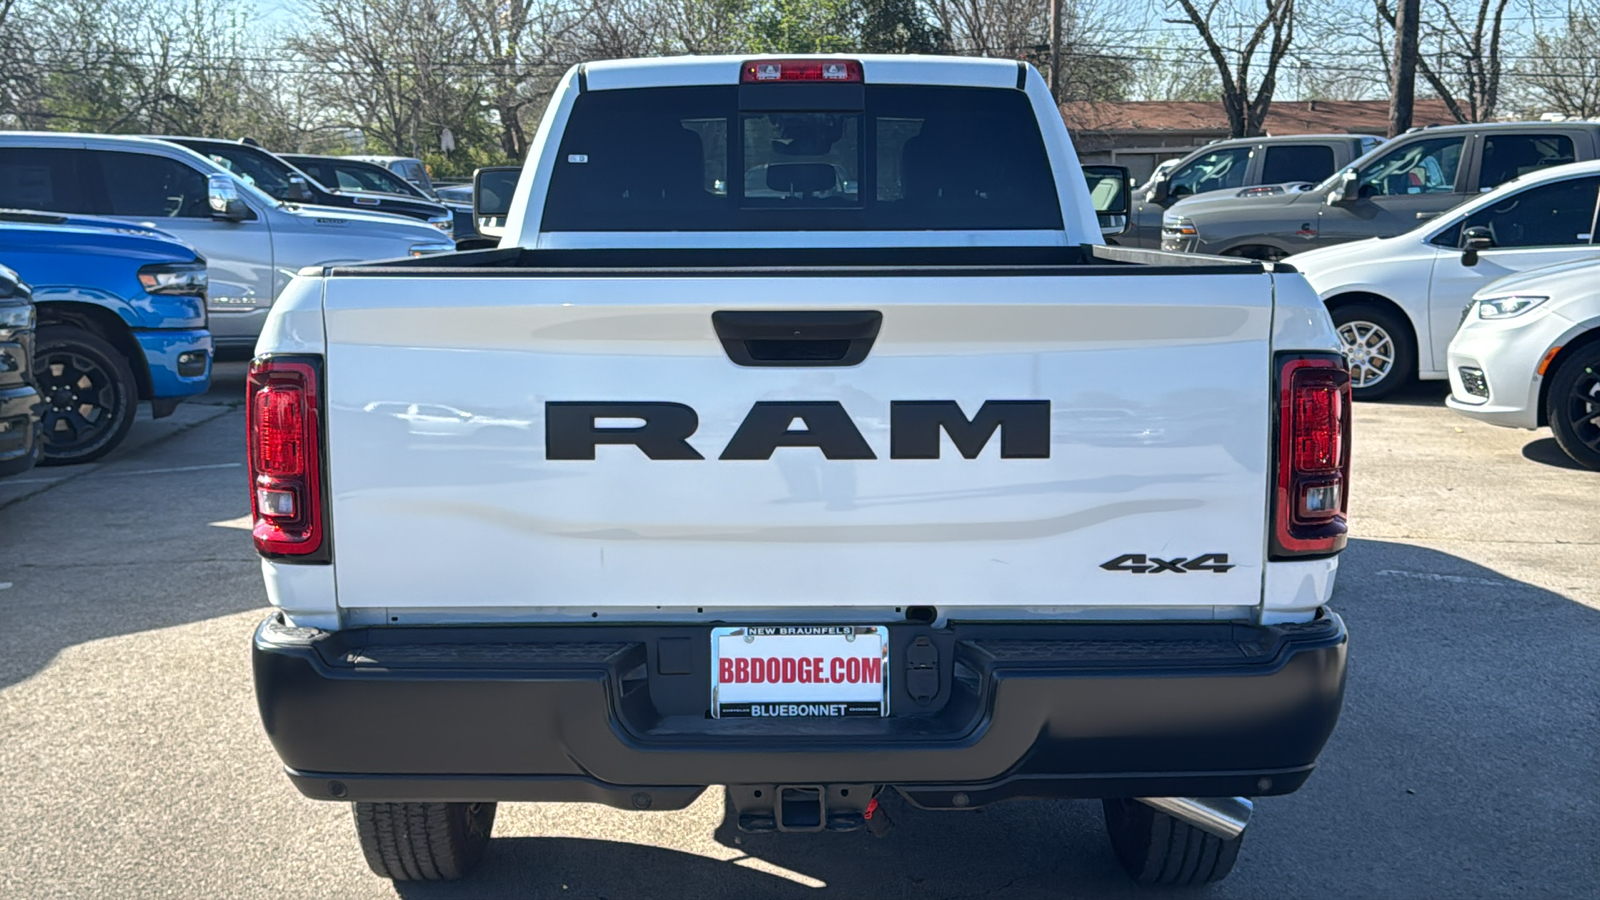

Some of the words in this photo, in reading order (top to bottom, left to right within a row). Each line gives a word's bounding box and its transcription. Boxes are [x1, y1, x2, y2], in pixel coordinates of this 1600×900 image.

[545, 400, 1051, 461] RAM
[1099, 553, 1236, 573] 4x4
[749, 627, 776, 635] NEW
[780, 626, 850, 635] BRAUNFELS
[719, 657, 881, 684] BBDODGE.COM
[751, 704, 847, 717] BLUEBONNET
